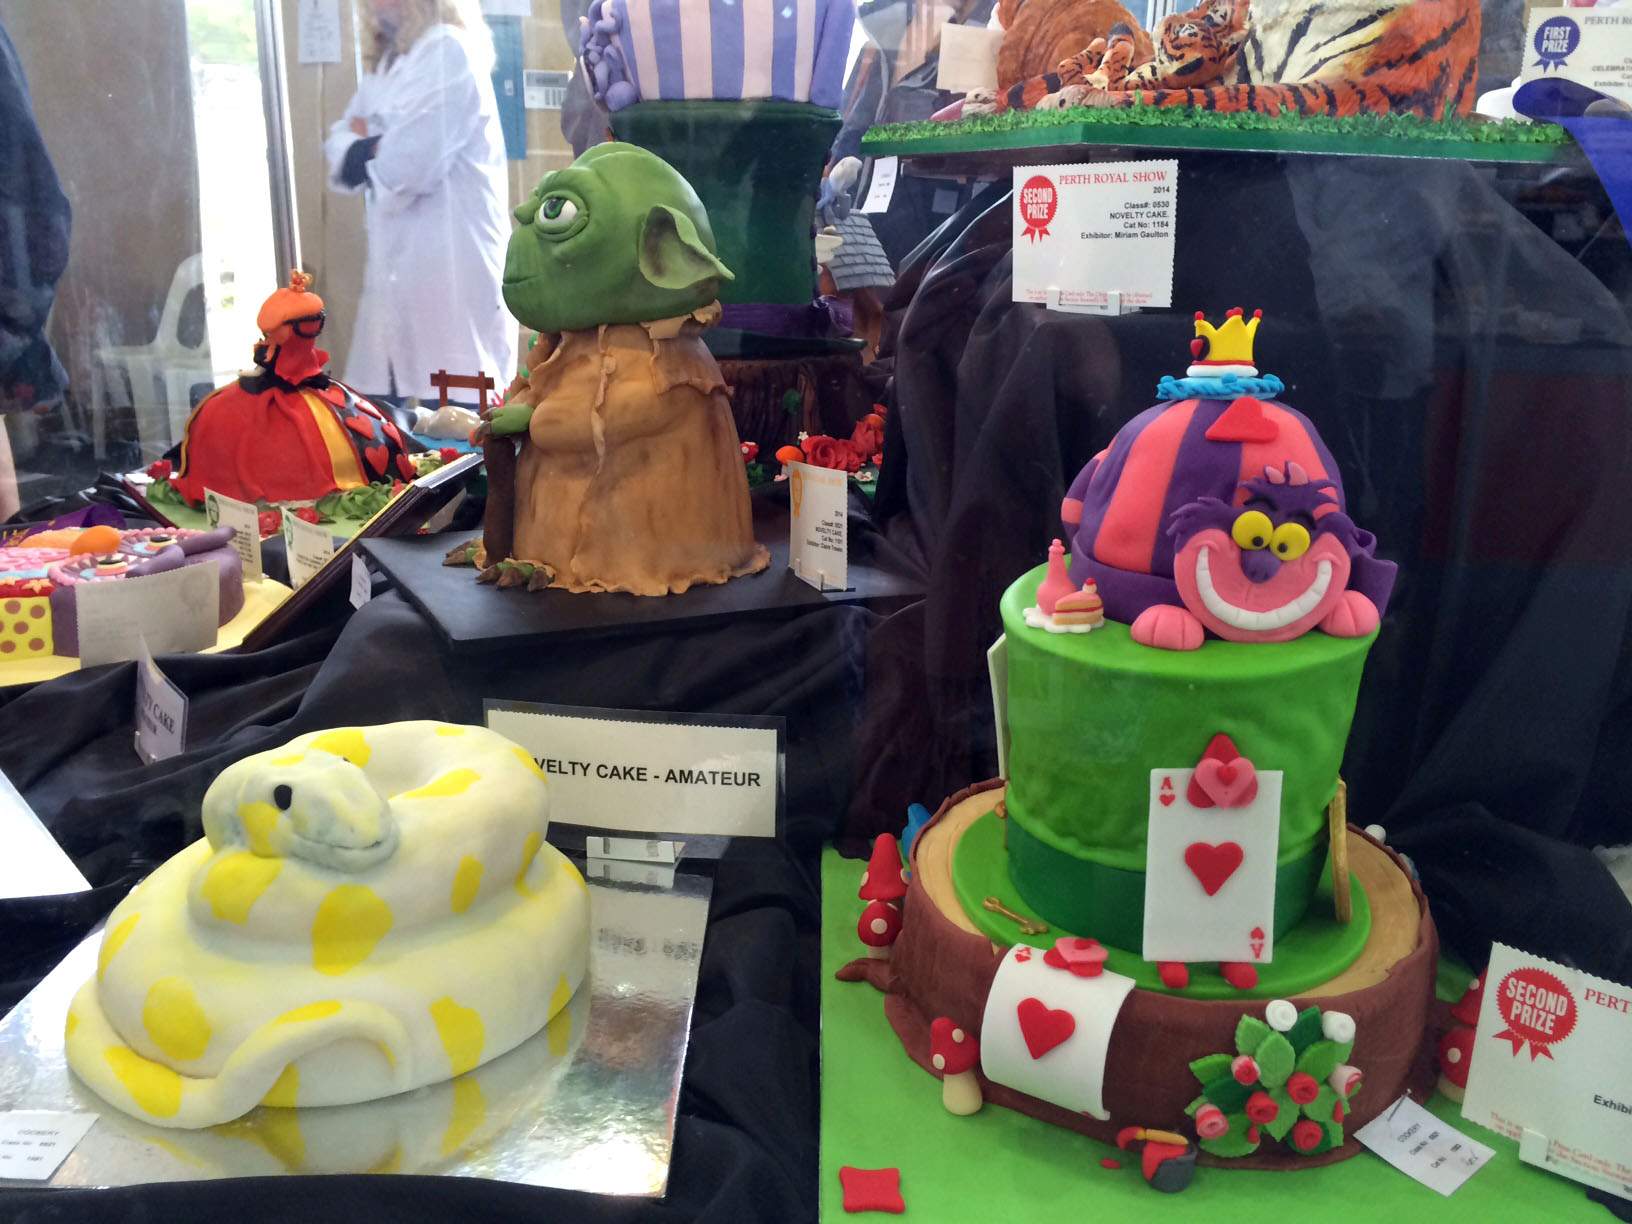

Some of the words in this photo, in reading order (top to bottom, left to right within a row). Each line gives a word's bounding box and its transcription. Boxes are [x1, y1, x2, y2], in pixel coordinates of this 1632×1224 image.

[1544, 26, 1571, 40] FIRST
[1542, 40, 1569, 52] PRIZE
[1059, 174, 1091, 185] PERTH
[1094, 173, 1129, 183] ROYAL
[1132, 171, 1168, 183] SHOW
[1023, 187, 1053, 203] SECOND
[1153, 186, 1170, 194] 2014
[1027, 203, 1049, 219] PRIZE
[1109, 211, 1144, 219] NOVELTY
[1115, 231, 1139, 239] Miriam
[153, 703, 175, 735] CAKE
[534, 757, 590, 777] VELTY
[596, 764, 647, 782] CAKE
[665, 769, 761, 787] AMATEUR
[1161, 776, 1174, 790] A
[1506, 977, 1568, 1018] SECOND
[1510, 1000, 1556, 1034] PRIZE
